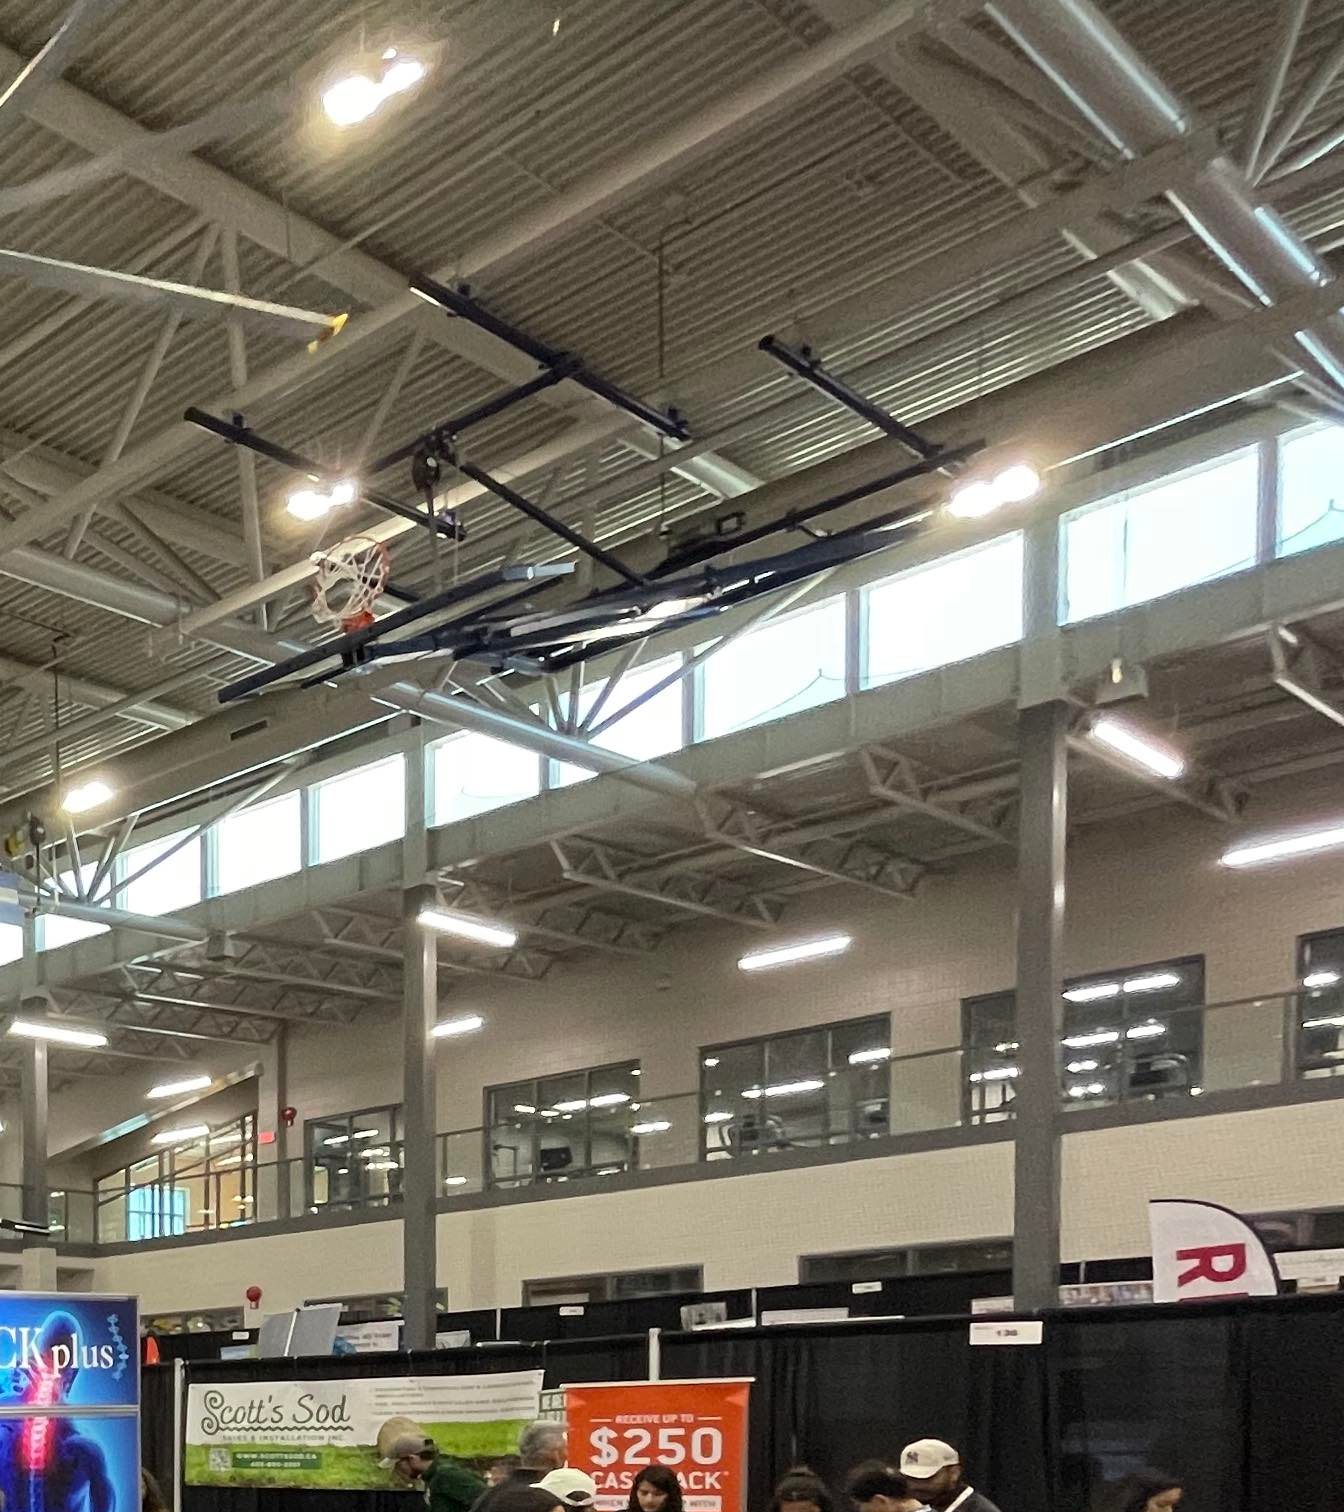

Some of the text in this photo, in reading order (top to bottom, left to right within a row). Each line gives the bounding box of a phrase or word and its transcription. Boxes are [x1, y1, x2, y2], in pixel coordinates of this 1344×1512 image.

[50, 1330, 115, 1375] plus
[200, 1389, 284, 1436] Scott's
[292, 1393, 351, 1424] Sod
[615, 1413, 695, 1425] RECEIVE UP TO
[589, 1426, 723, 1468] $250
[591, 1471, 729, 1490] CAS ACK
